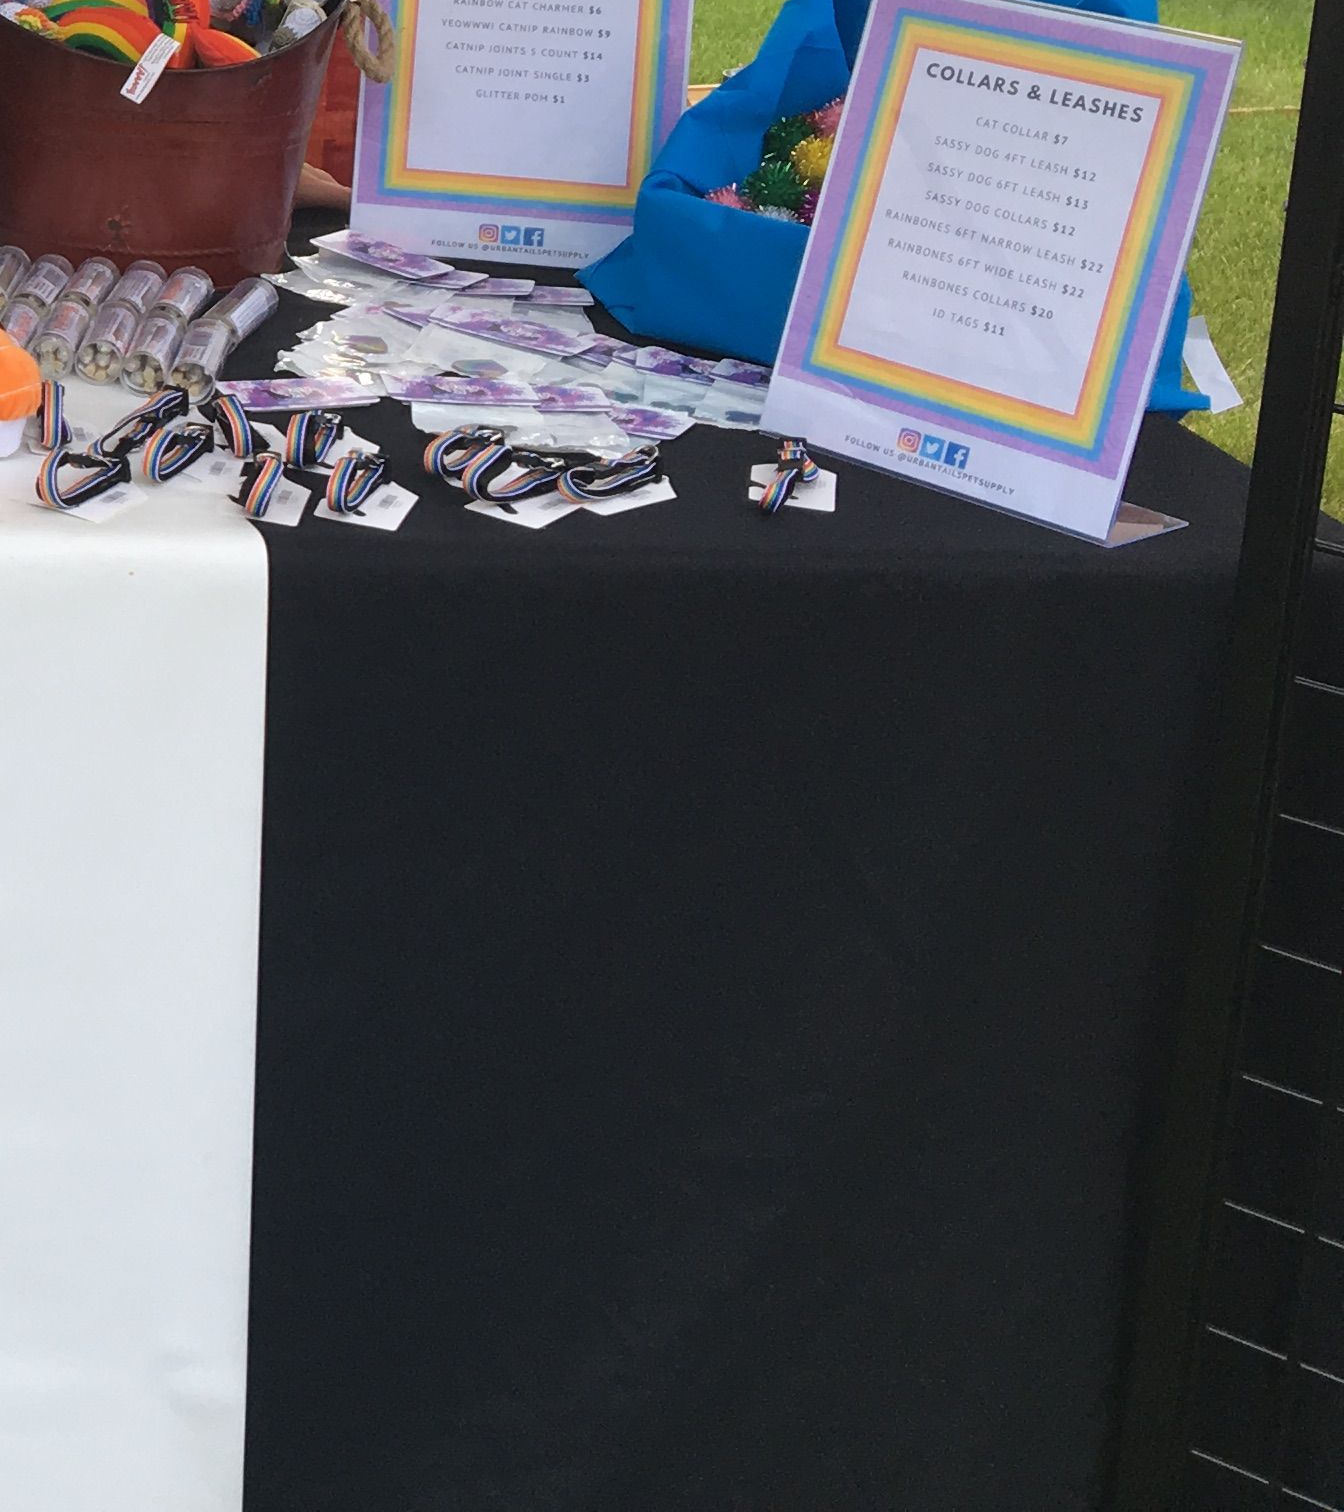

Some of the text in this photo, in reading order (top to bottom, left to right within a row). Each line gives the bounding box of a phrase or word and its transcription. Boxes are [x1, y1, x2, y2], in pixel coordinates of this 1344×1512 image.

[507, 0, 529, 11] CAT
[532, 2, 585, 15] CHARMER
[588, 5, 603, 16] $6
[498, 22, 539, 34] CATNIP
[542, 25, 594, 38] RAINBOW
[597, 29, 612, 39] $9
[445, 41, 486, 53] CATNIP
[488, 45, 527, 56] JOINTS
[540, 48, 579, 59] COUNT
[582, 51, 603, 62] $14
[455, 64, 496, 76] CATNIP
[497, 68, 530, 79] JOINT
[533, 71, 573, 82] SINGLE
[475, 89, 566, 104] GLITTER POM $1
[926, 62, 1145, 124] COLLARS & LEASHES
[975, 116, 1069, 145] CAT COLLAR $7
[934, 135, 1098, 183] SASSY DOG 4FT LEASH $12
[927, 161, 965, 179] SASSY
[967, 171, 993, 187] DOG
[996, 178, 1020, 193] 6FT
[1022, 185, 1062, 204] LEASH
[924, 190, 1077, 237] SASSY DOG COLLARS $12
[431, 239, 590, 259] FOLLOW US @URBANTAILSPETSUPPLY
[884, 208, 1105, 274] RAINBONES 6FT NARROW LEASH $22
[887, 237, 1086, 299] RAINBONES 6FT WIDE LEASH $22
[901, 270, 1055, 320] RAINBONES COLLARS $20
[931, 307, 1006, 337] ID TAGS $11
[844, 434, 1016, 496] FOLLOW US @URBANTAILSPETSUPPLY
